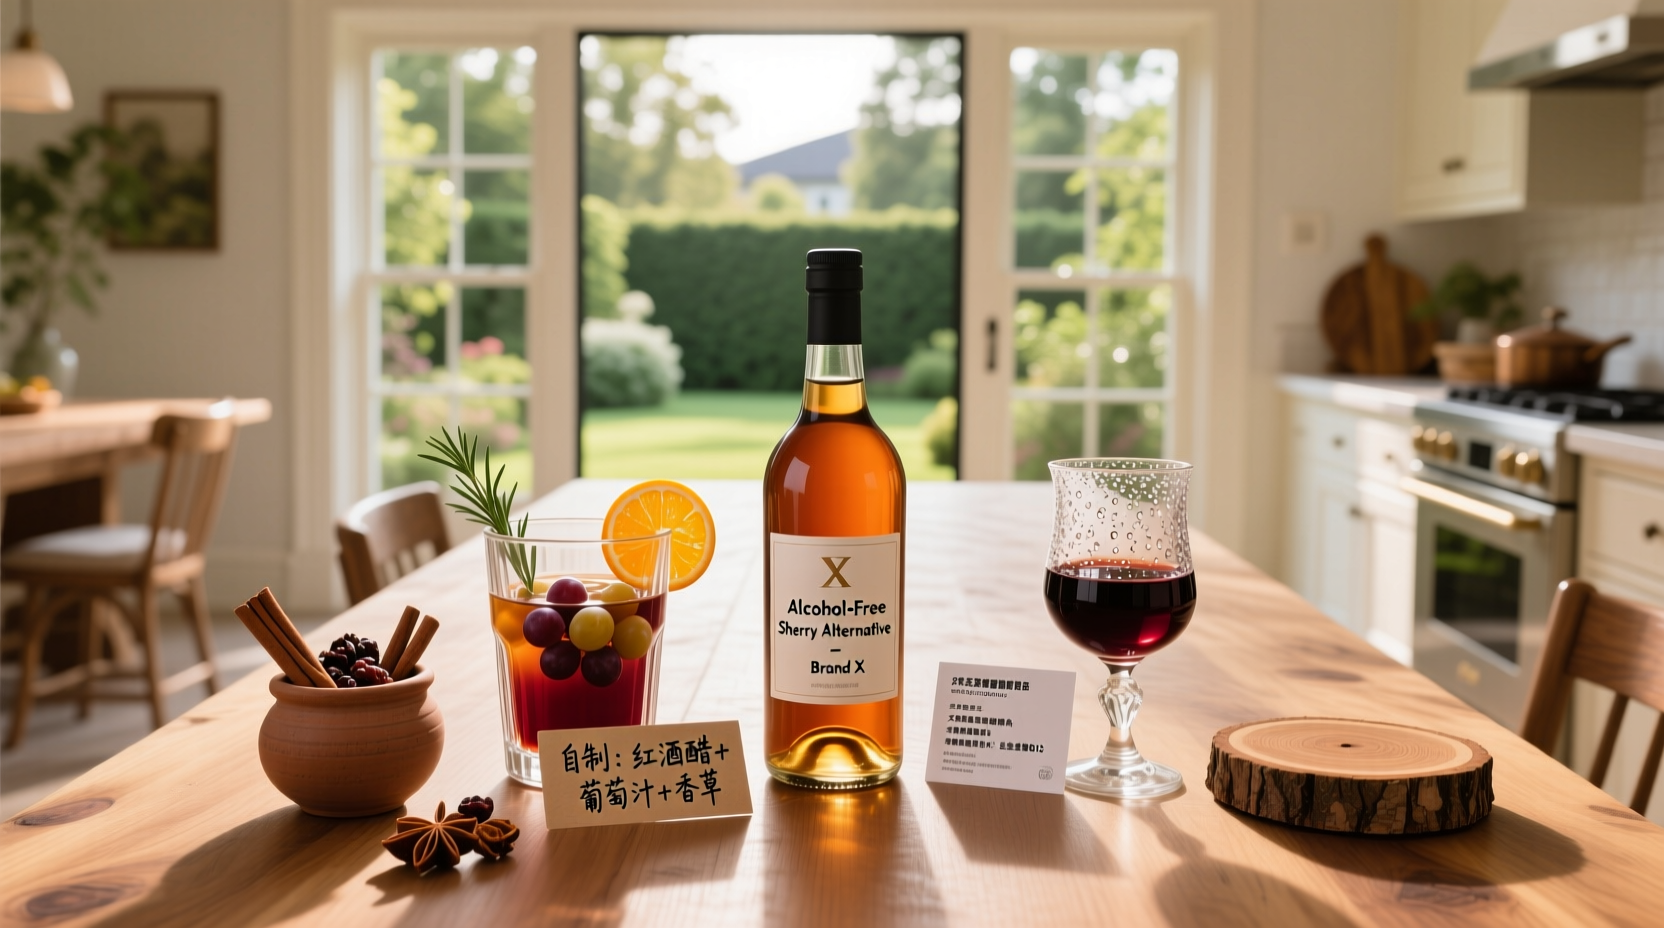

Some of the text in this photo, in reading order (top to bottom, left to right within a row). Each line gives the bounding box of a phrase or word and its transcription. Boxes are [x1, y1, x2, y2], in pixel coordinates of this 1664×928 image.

[820, 556, 852, 588] X
[787, 598, 887, 616] Alcohol-Free
[778, 620, 891, 641] Sherry Alternative
[810, 659, 866, 675] Brand X
[579, 767, 722, 814] 葡萄汁+香草
